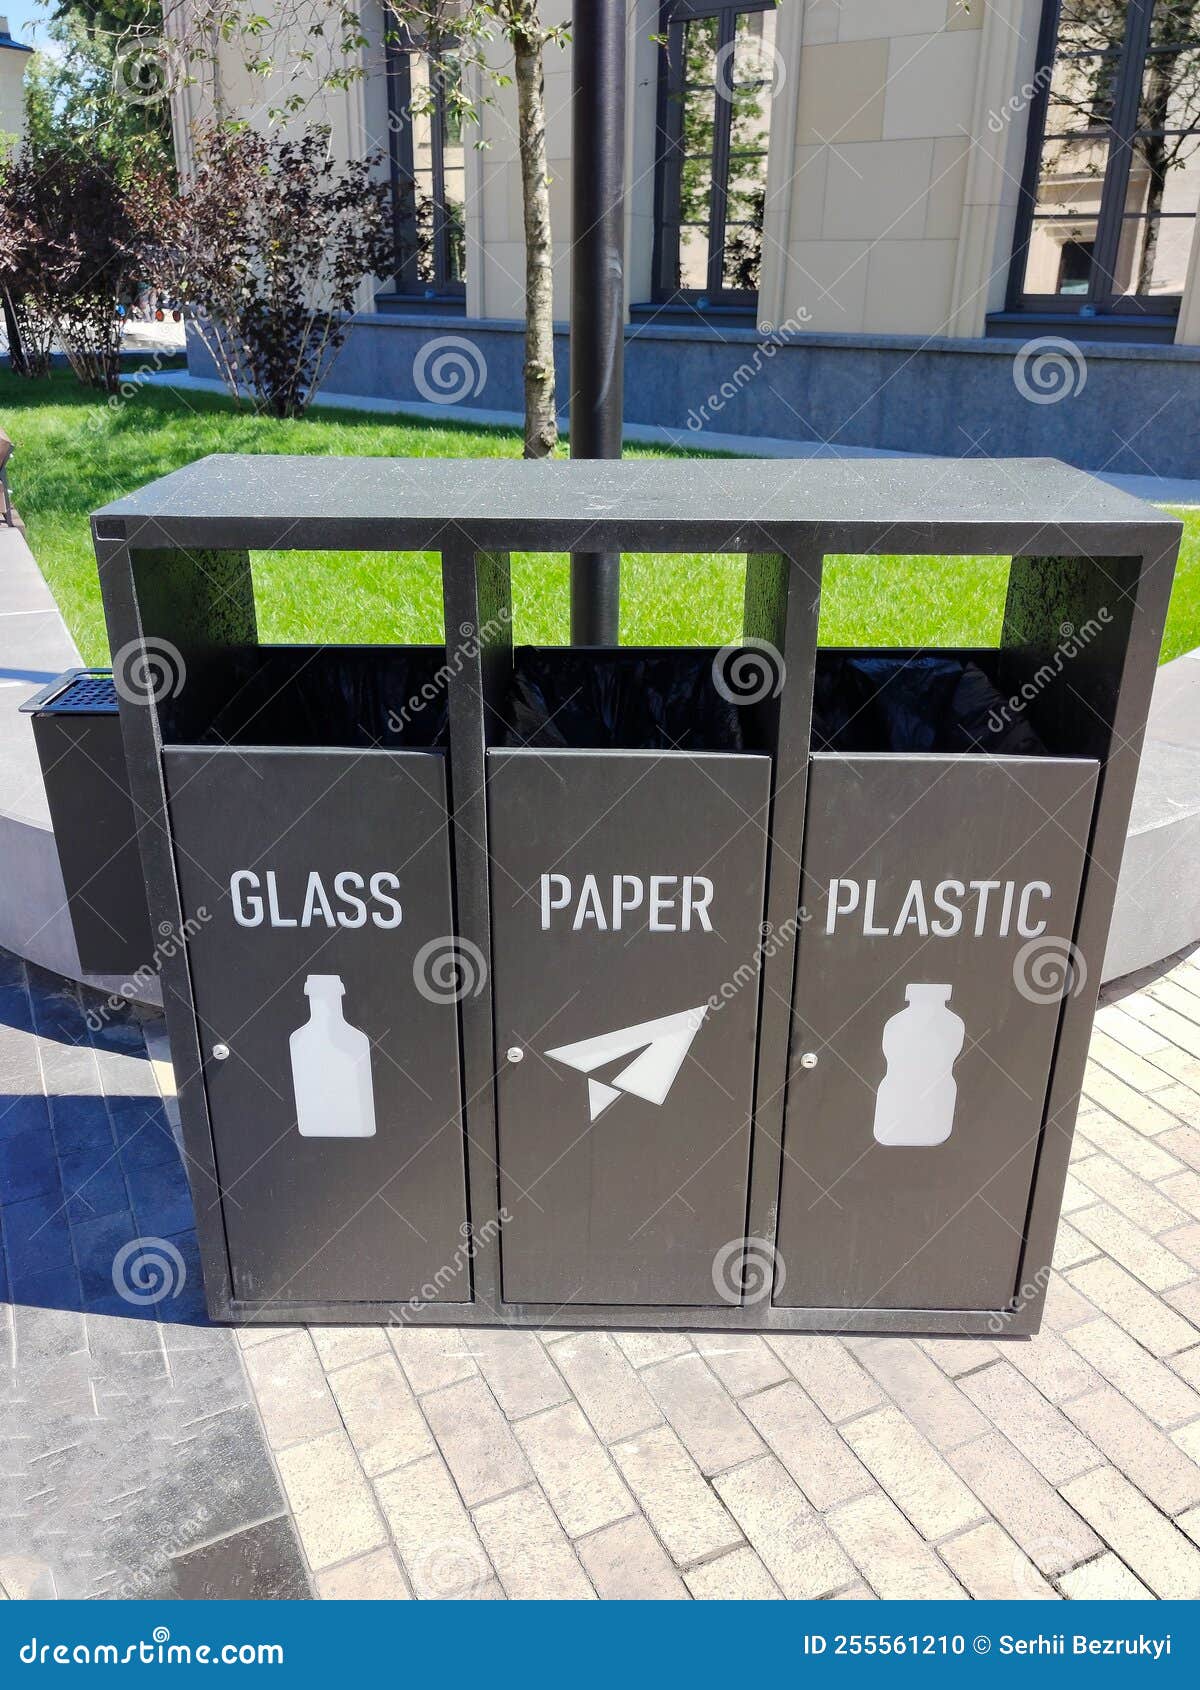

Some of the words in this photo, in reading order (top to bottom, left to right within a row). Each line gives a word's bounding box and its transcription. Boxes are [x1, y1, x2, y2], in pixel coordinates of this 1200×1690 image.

[230, 869, 403, 929] GLASS
[540, 873, 714, 933] PAPER
[825, 878, 1052, 939] PLASTIC
